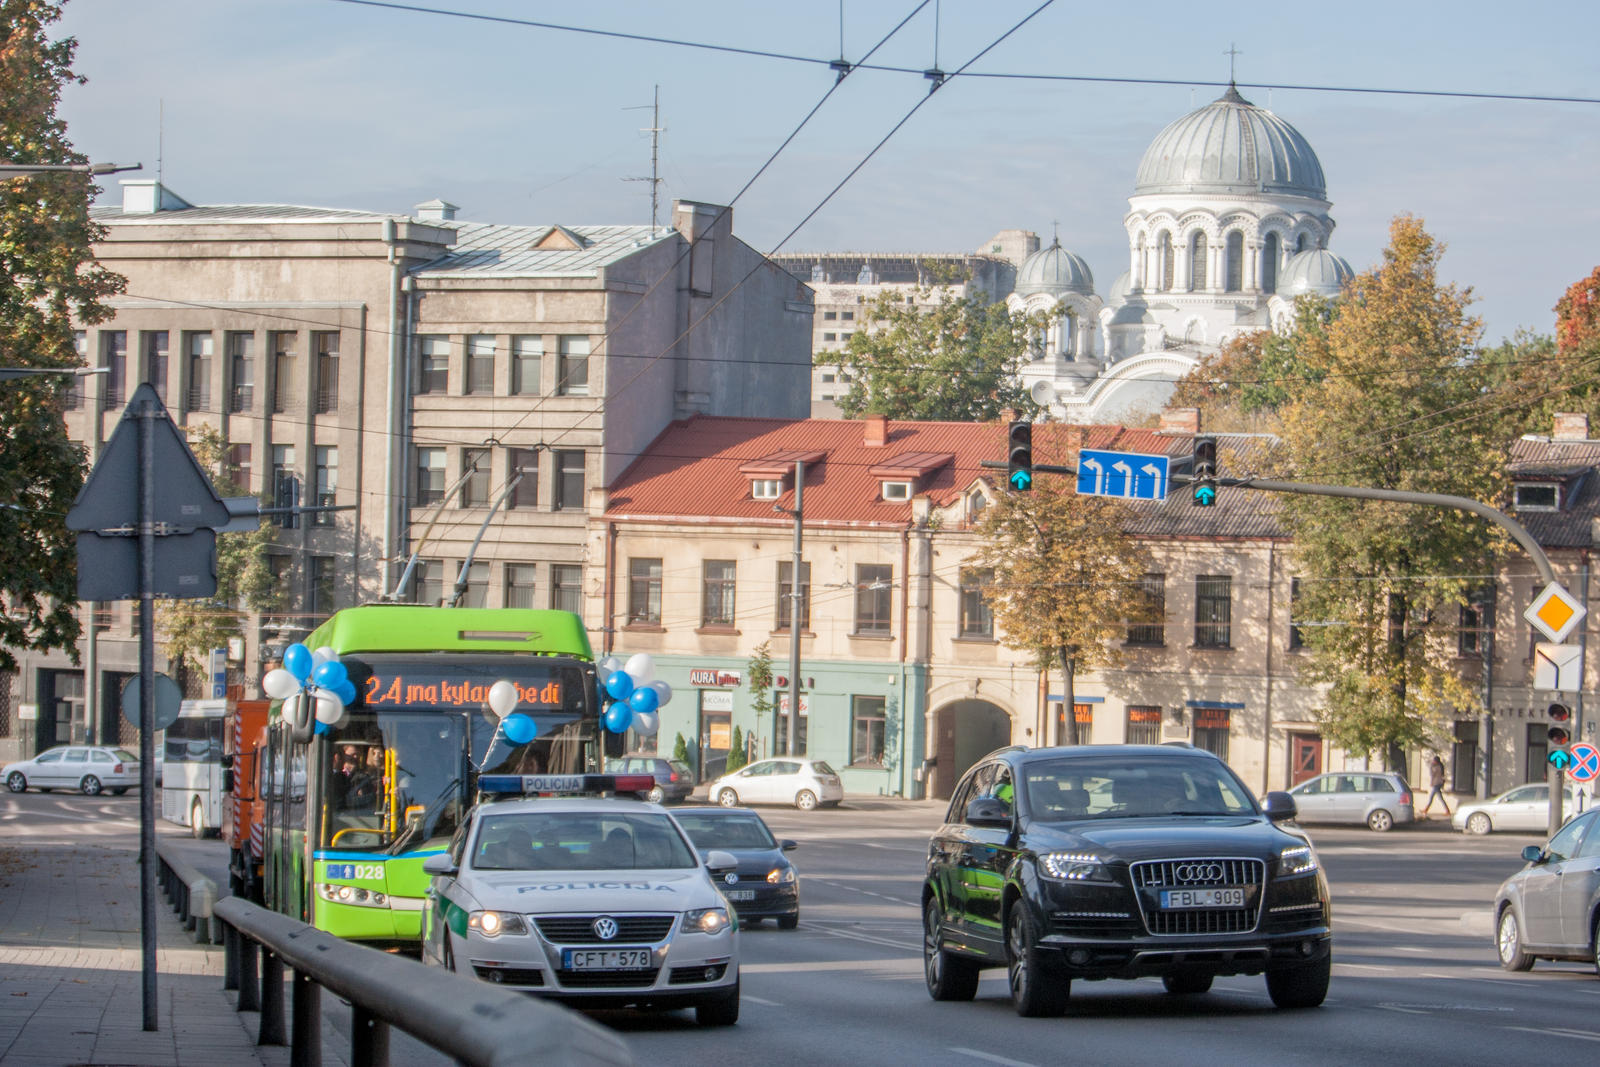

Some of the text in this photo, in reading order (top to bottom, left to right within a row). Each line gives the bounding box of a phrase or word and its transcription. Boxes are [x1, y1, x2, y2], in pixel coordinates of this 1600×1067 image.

[691, 671, 716, 685] AURA
[525, 778, 580, 790] POLICIJA
[355, 864, 385, 880] 028
[517, 882, 677, 894] POLICIJA
[1170, 890, 1243, 906] FBL 909
[574, 952, 609, 967] CFT
[619, 951, 649, 967] 578
